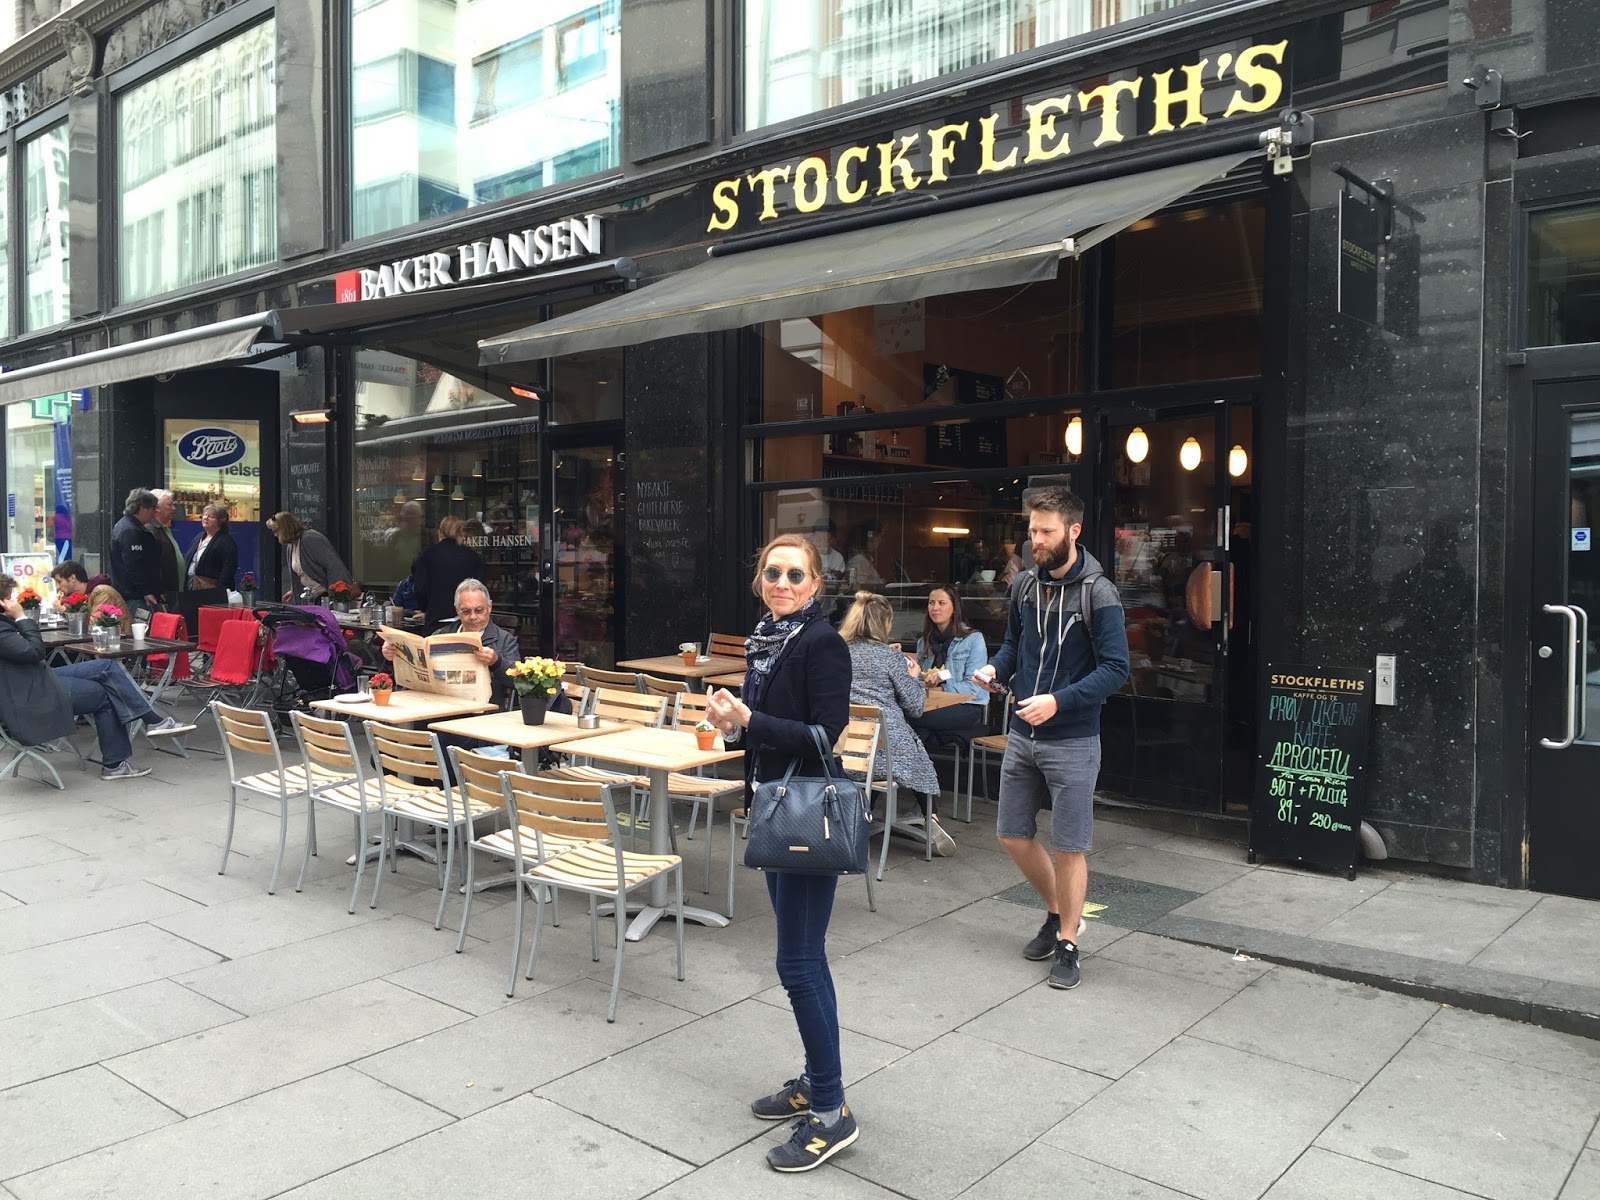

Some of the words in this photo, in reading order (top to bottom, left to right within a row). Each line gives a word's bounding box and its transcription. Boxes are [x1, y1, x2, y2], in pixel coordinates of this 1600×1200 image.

[707, 39, 1289, 233] STOCKFLETH'S
[360, 251, 451, 301] BAKER
[457, 213, 604, 281] HANSEN
[187, 435, 238, 461] Boots
[492, 535, 532, 547] HANSEN
[13, 564, 34, 577] 50
[1271, 674, 1365, 691] STOCKFLETHS
[1293, 692, 1314, 700] KAFFE
